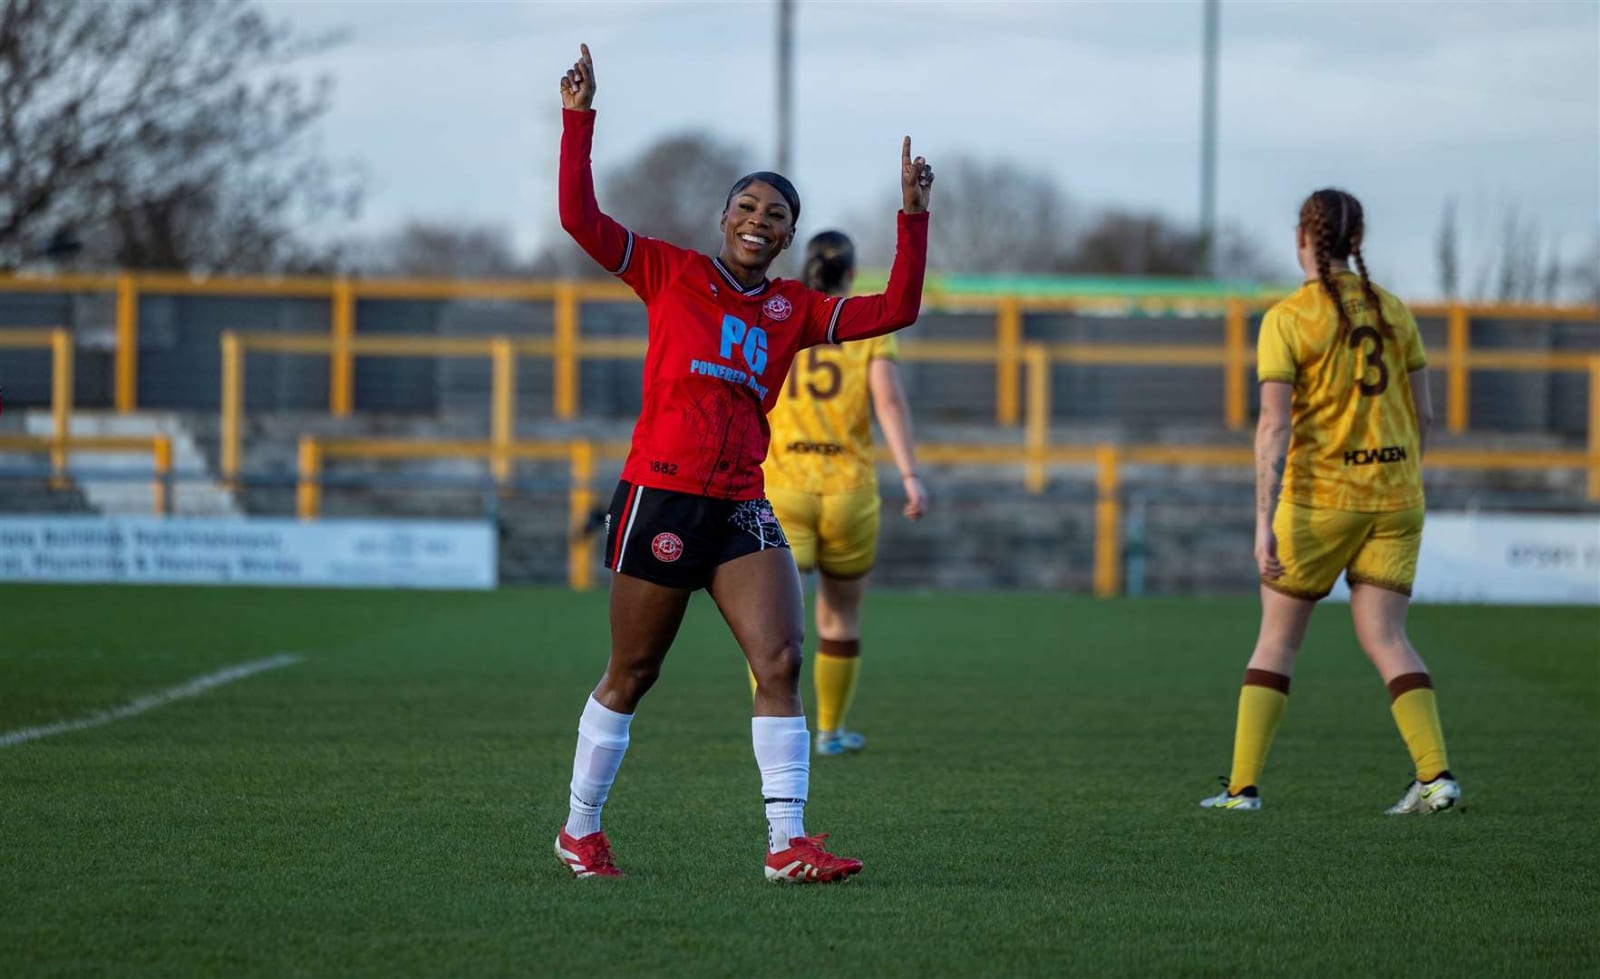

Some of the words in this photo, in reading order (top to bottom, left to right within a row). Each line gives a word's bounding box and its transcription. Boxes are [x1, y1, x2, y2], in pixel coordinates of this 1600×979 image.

[719, 314, 768, 376] PG
[1350, 325, 1388, 397] 3
[690, 359, 747, 384] POWERED
[788, 343, 844, 401] 15
[649, 460, 679, 476] 1882
[1343, 446, 1407, 466] HOWDEN
